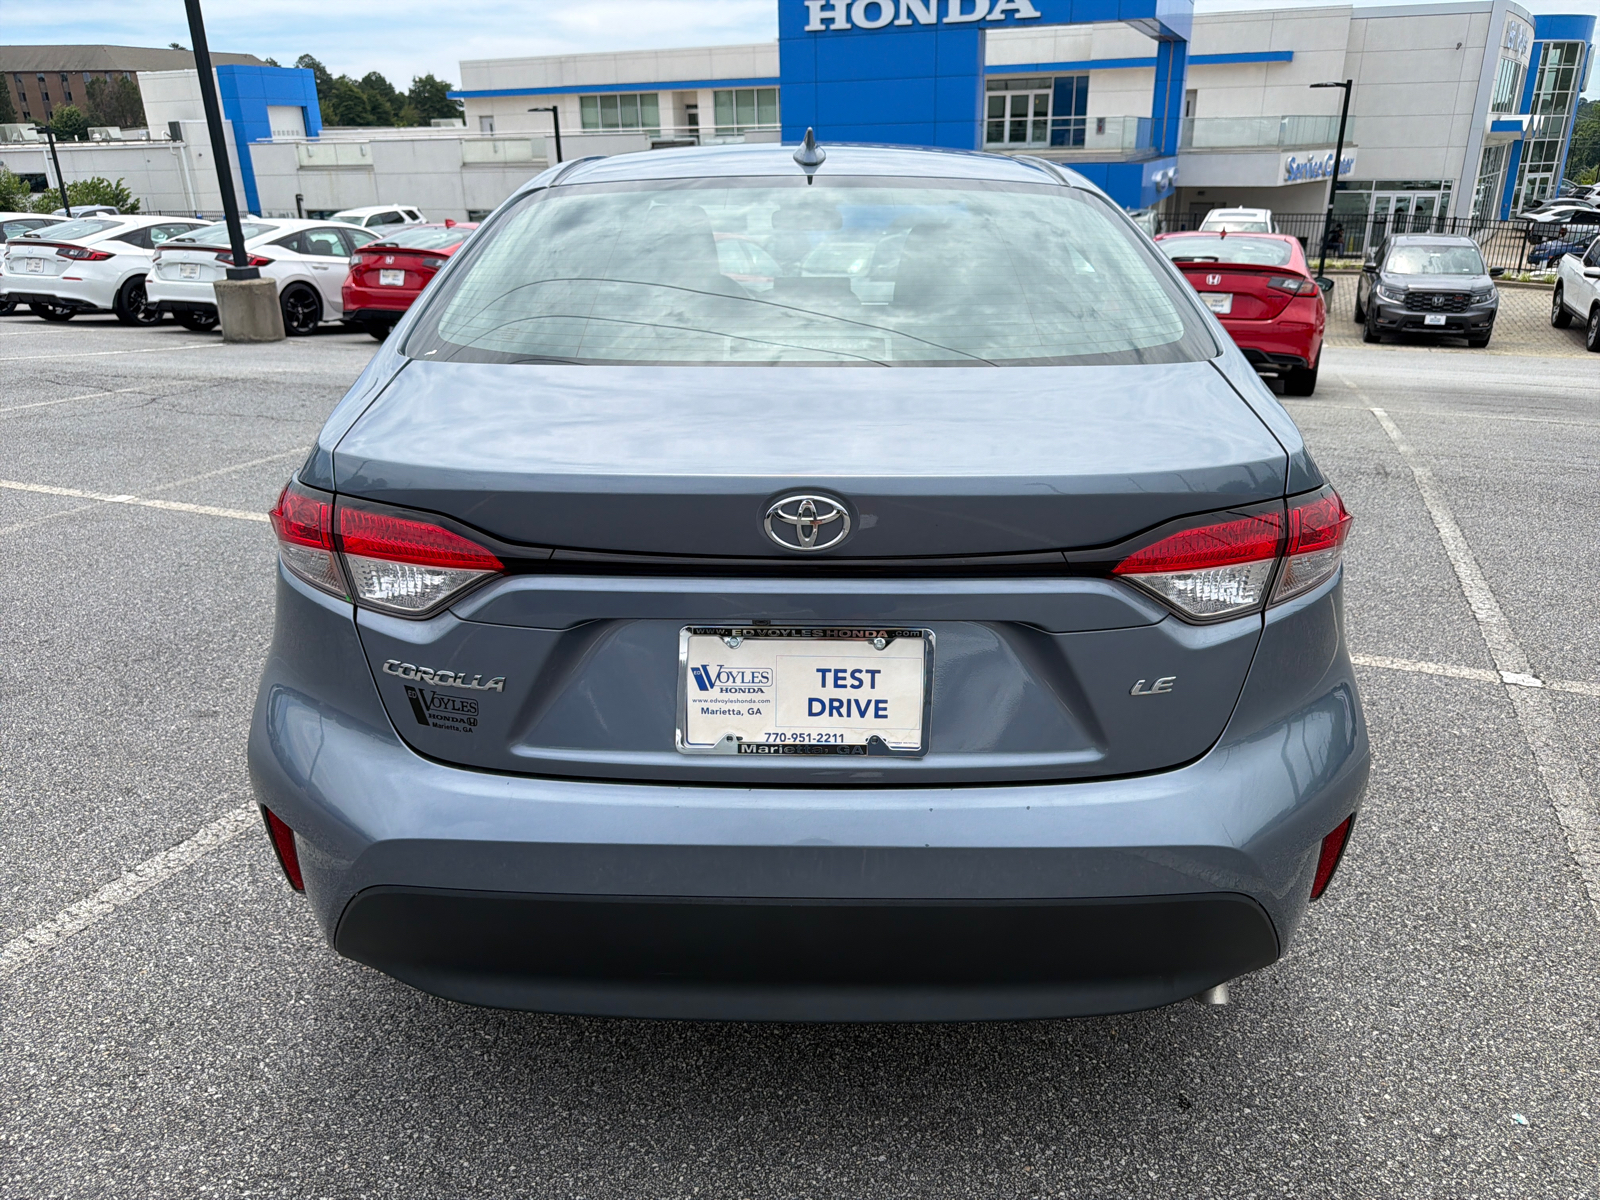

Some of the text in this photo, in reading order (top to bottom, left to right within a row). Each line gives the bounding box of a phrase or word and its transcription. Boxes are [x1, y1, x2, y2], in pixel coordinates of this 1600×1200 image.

[804, 0, 1042, 32] HONDA
[1284, 154, 1323, 182] Service
[382, 659, 507, 693] COROLLA
[700, 664, 770, 690] VOYLES
[816, 668, 882, 690] TEST
[1129, 675, 1177, 696] LE
[418, 688, 478, 714] VOYLES
[691, 697, 771, 705] www.edvoyleshonda.com
[700, 707, 762, 717] Marietta, GA
[807, 697, 889, 719] DRIVE
[428, 713, 467, 724] HONDA
[432, 721, 474, 734] Marietta, GA
[764, 732, 845, 744] 770-951-2211
